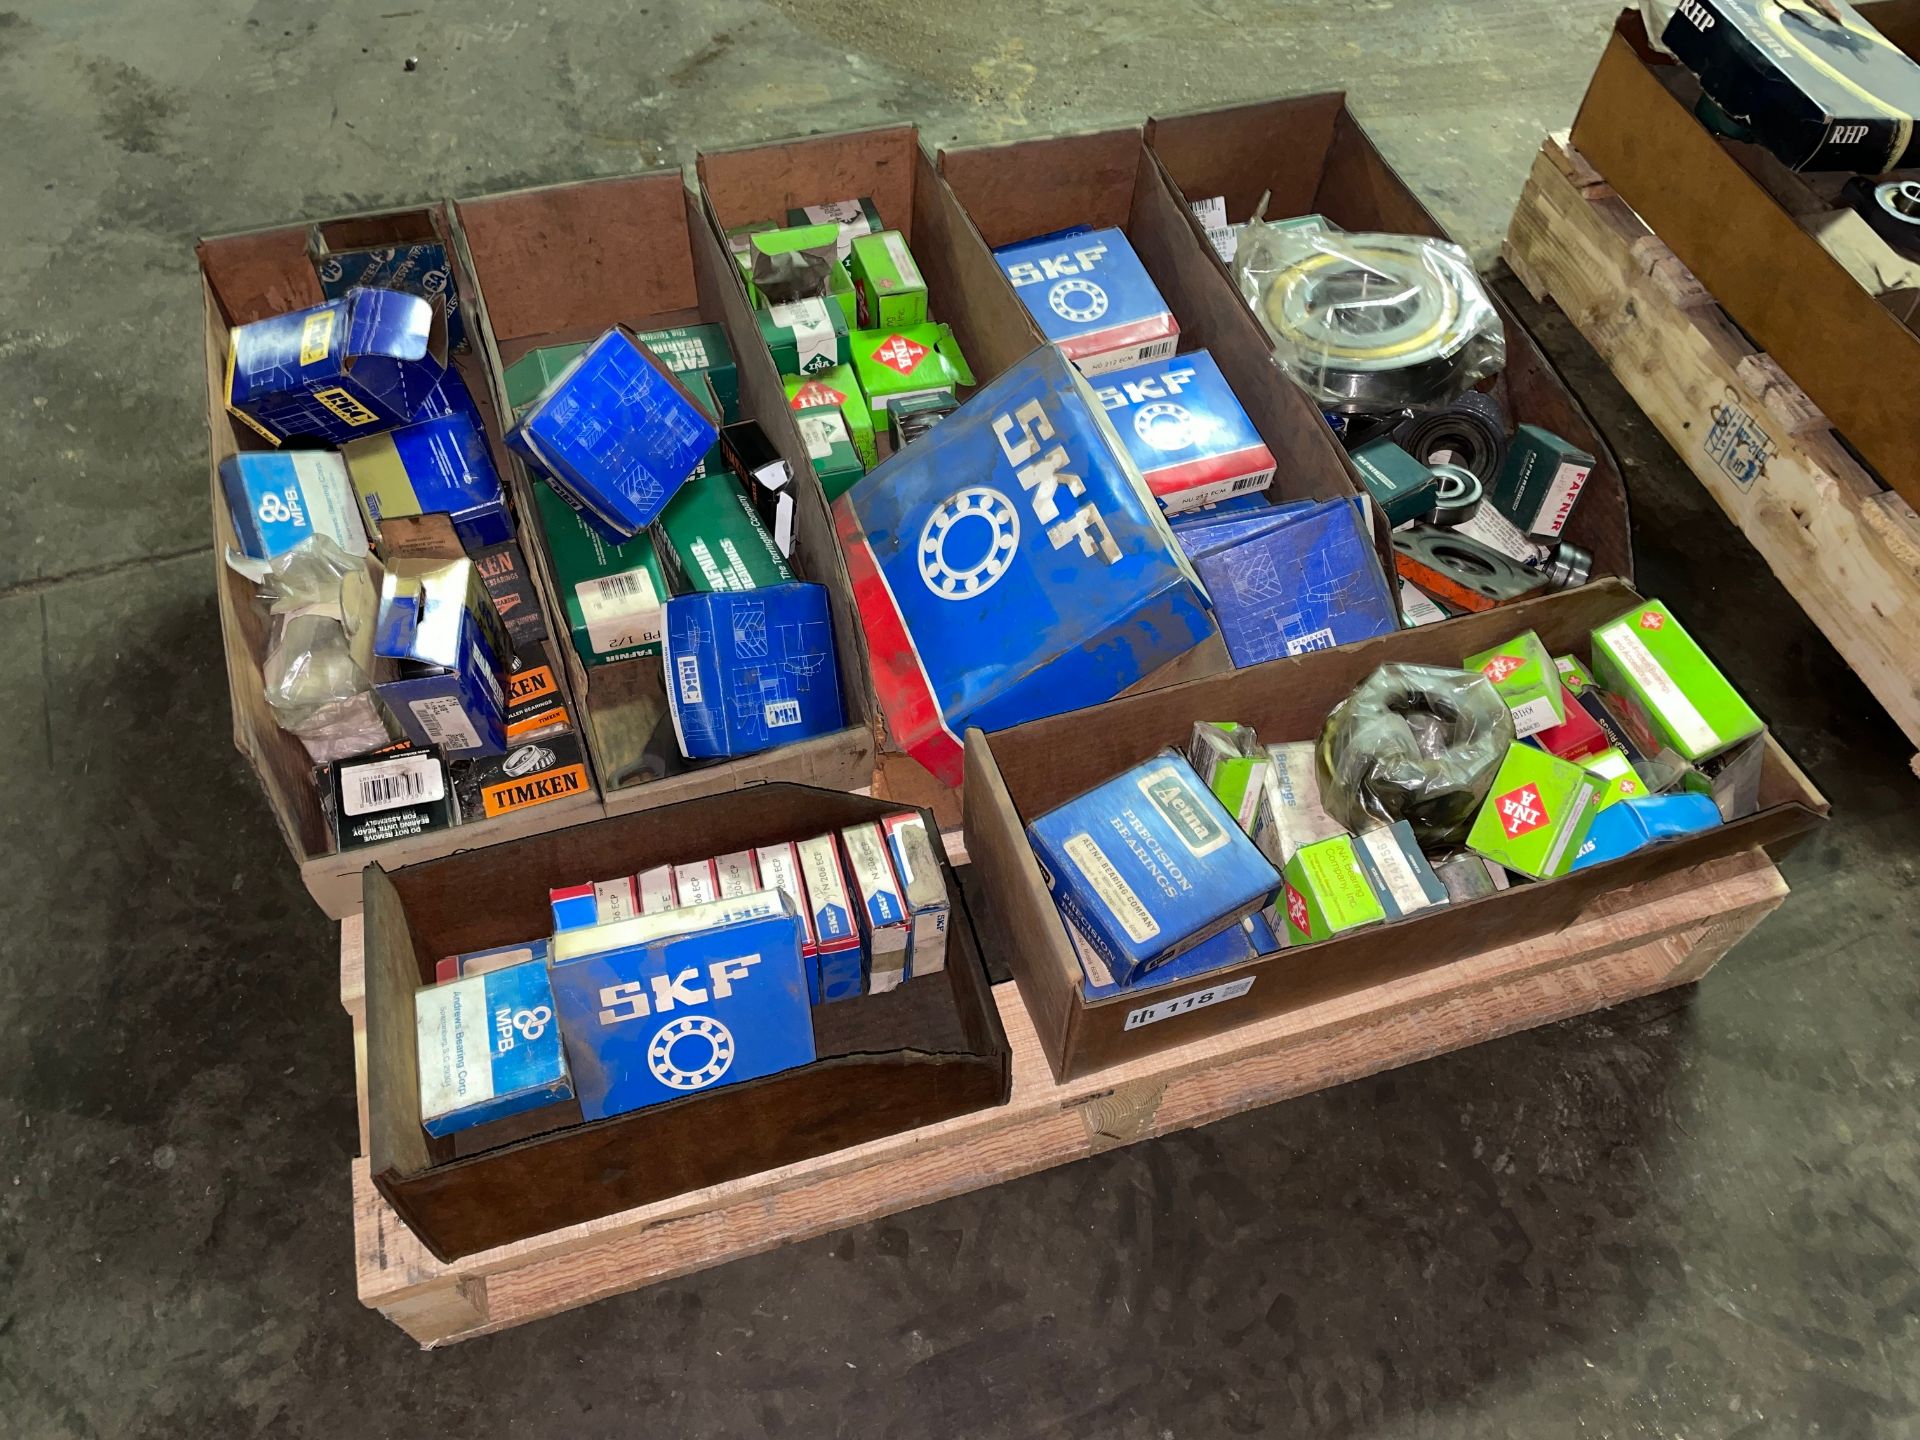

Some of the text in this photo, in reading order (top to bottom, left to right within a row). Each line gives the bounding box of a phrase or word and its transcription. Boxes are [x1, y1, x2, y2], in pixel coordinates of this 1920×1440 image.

[1680, 0, 1716, 32] RHP
[1829, 126, 1869, 144] RHP
[1008, 244, 1108, 287] SKF
[1092, 355, 1134, 371] NU 212 ECM
[1095, 367, 1196, 411] SKF
[325, 392, 370, 423] RBC
[992, 398, 1124, 565] SKF
[1182, 496, 1194, 504] NU
[1210, 487, 1226, 497] ECM
[284, 486, 306, 527] MPB
[1551, 471, 1587, 532] FAFNIR
[736, 494, 791, 580] The Torrington Company
[719, 537, 757, 589] BEARINGS
[606, 648, 653, 662] FAFNIR
[609, 635, 633, 648] 1/2
[508, 673, 547, 700] KEN
[683, 660, 700, 699] RBC
[525, 699, 553, 714] BEARINGS
[538, 711, 561, 724] TIMKEN
[768, 706, 799, 726] RBC
[493, 771, 579, 809] TIMKEN
[1275, 751, 1297, 807] Bearings
[353, 816, 430, 837] BEARING UNTIL READY
[365, 815, 401, 827] ASSEMBLY
[1154, 786, 1210, 841] Aetna
[363, 826, 421, 843] DO NOT REMOVE
[814, 851, 823, 866] ECP
[861, 841, 871, 857] ECP
[1110, 816, 1179, 898] BEARINGS
[1122, 808, 1193, 892] PRECISION
[772, 858, 782, 874] ECP
[818, 867, 828, 883] 206
[866, 857, 876, 873] 206
[1335, 845, 1365, 898] INA Bearing
[690, 876, 701, 891] ECP
[729, 864, 744, 897] 206 ECP
[1082, 838, 1103, 862] AETNA
[1101, 862, 1128, 896] BEARING
[1127, 896, 1157, 932] COMPANY
[610, 893, 620, 909] ECP
[875, 892, 892, 919] SKF
[825, 906, 840, 934] SKF
[936, 914, 945, 932] SKF
[1062, 891, 1117, 962] PRECISION
[598, 953, 762, 1026] SKF
[1166, 992, 1216, 1013] 118
[453, 991, 468, 1097] Andrews Bearing Corp.
[495, 1007, 515, 1054] MPB
